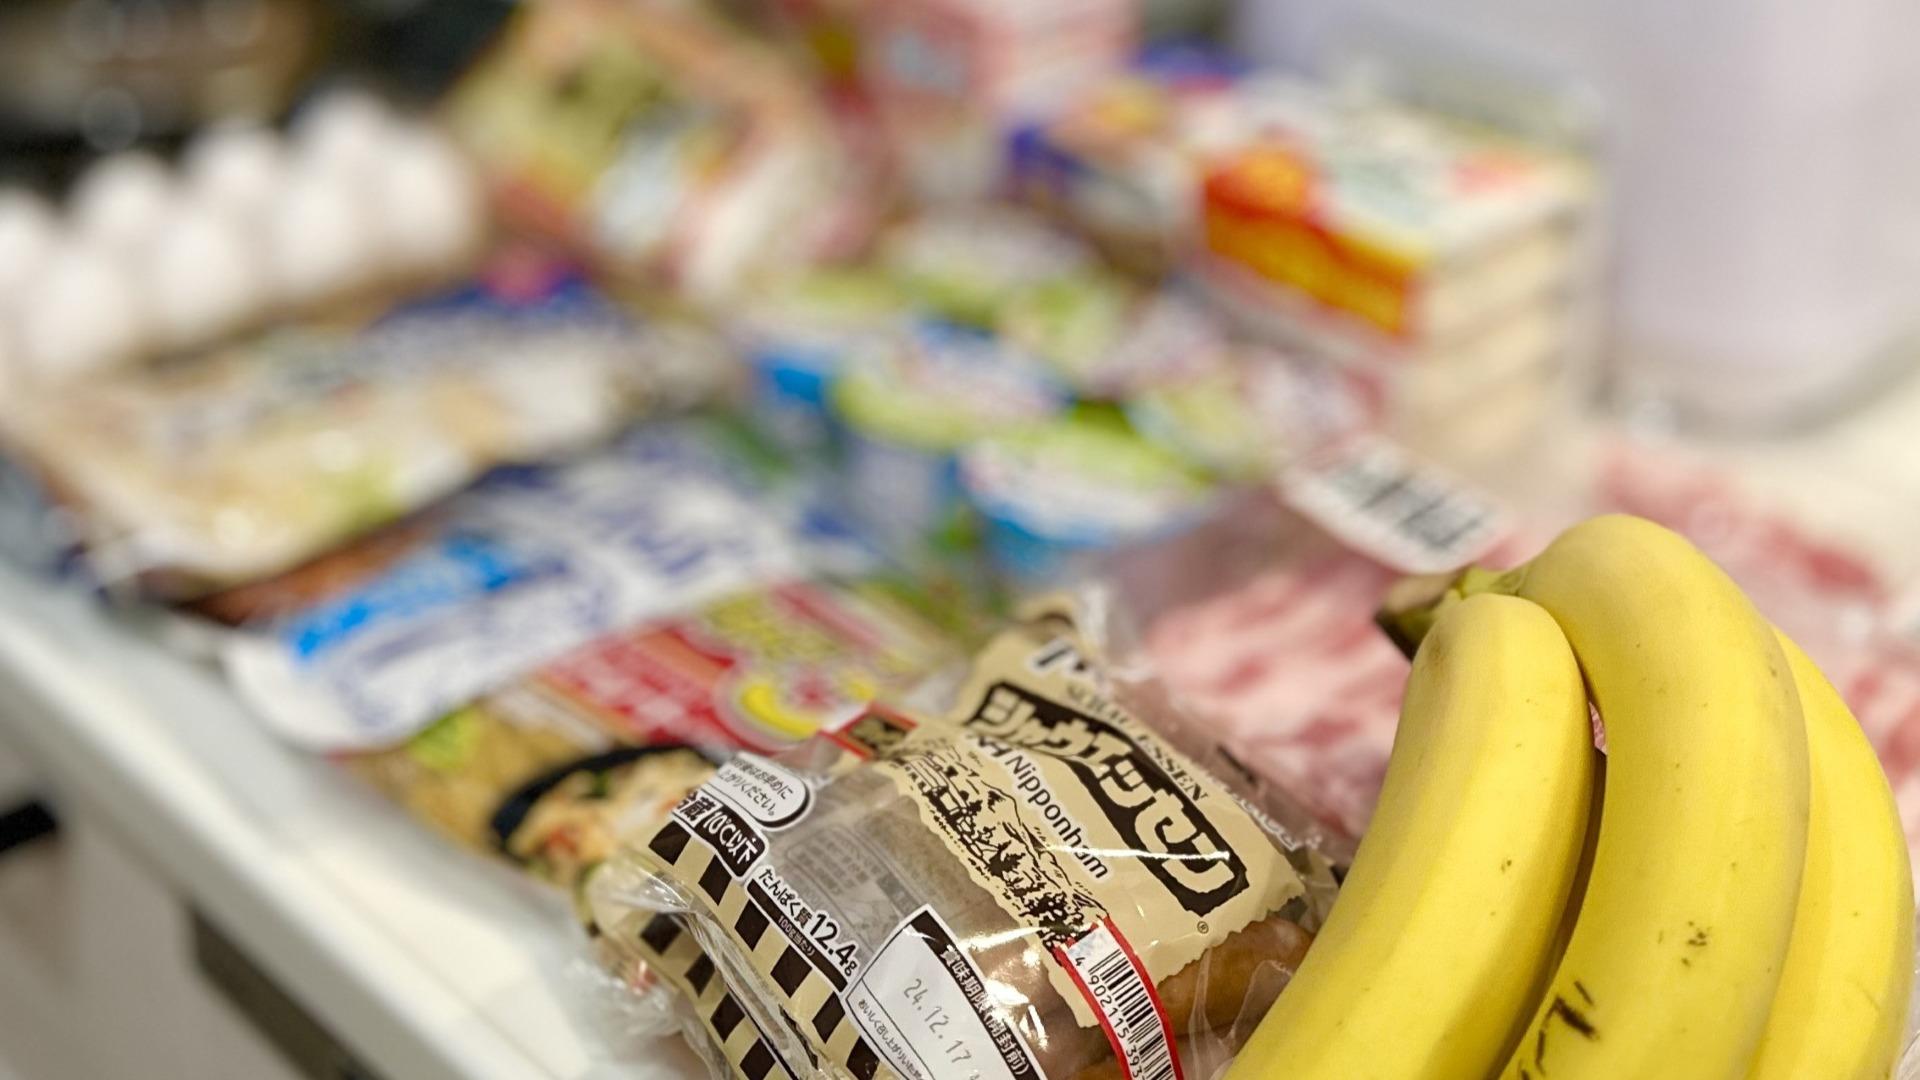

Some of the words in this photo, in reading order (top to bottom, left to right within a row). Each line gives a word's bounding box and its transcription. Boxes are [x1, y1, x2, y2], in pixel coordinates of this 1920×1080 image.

[966, 687, 1236, 894] シャウエッセン
[1005, 755, 1109, 879] Nipponham
[1137, 733, 1209, 801] ESSEN
[778, 915, 816, 956] 100g当たり
[903, 978, 972, 1063] 24.12.17
[1074, 956, 1086, 967] 4
[1088, 974, 1130, 1039] 902115
[1126, 1044, 1145, 1080] 393
